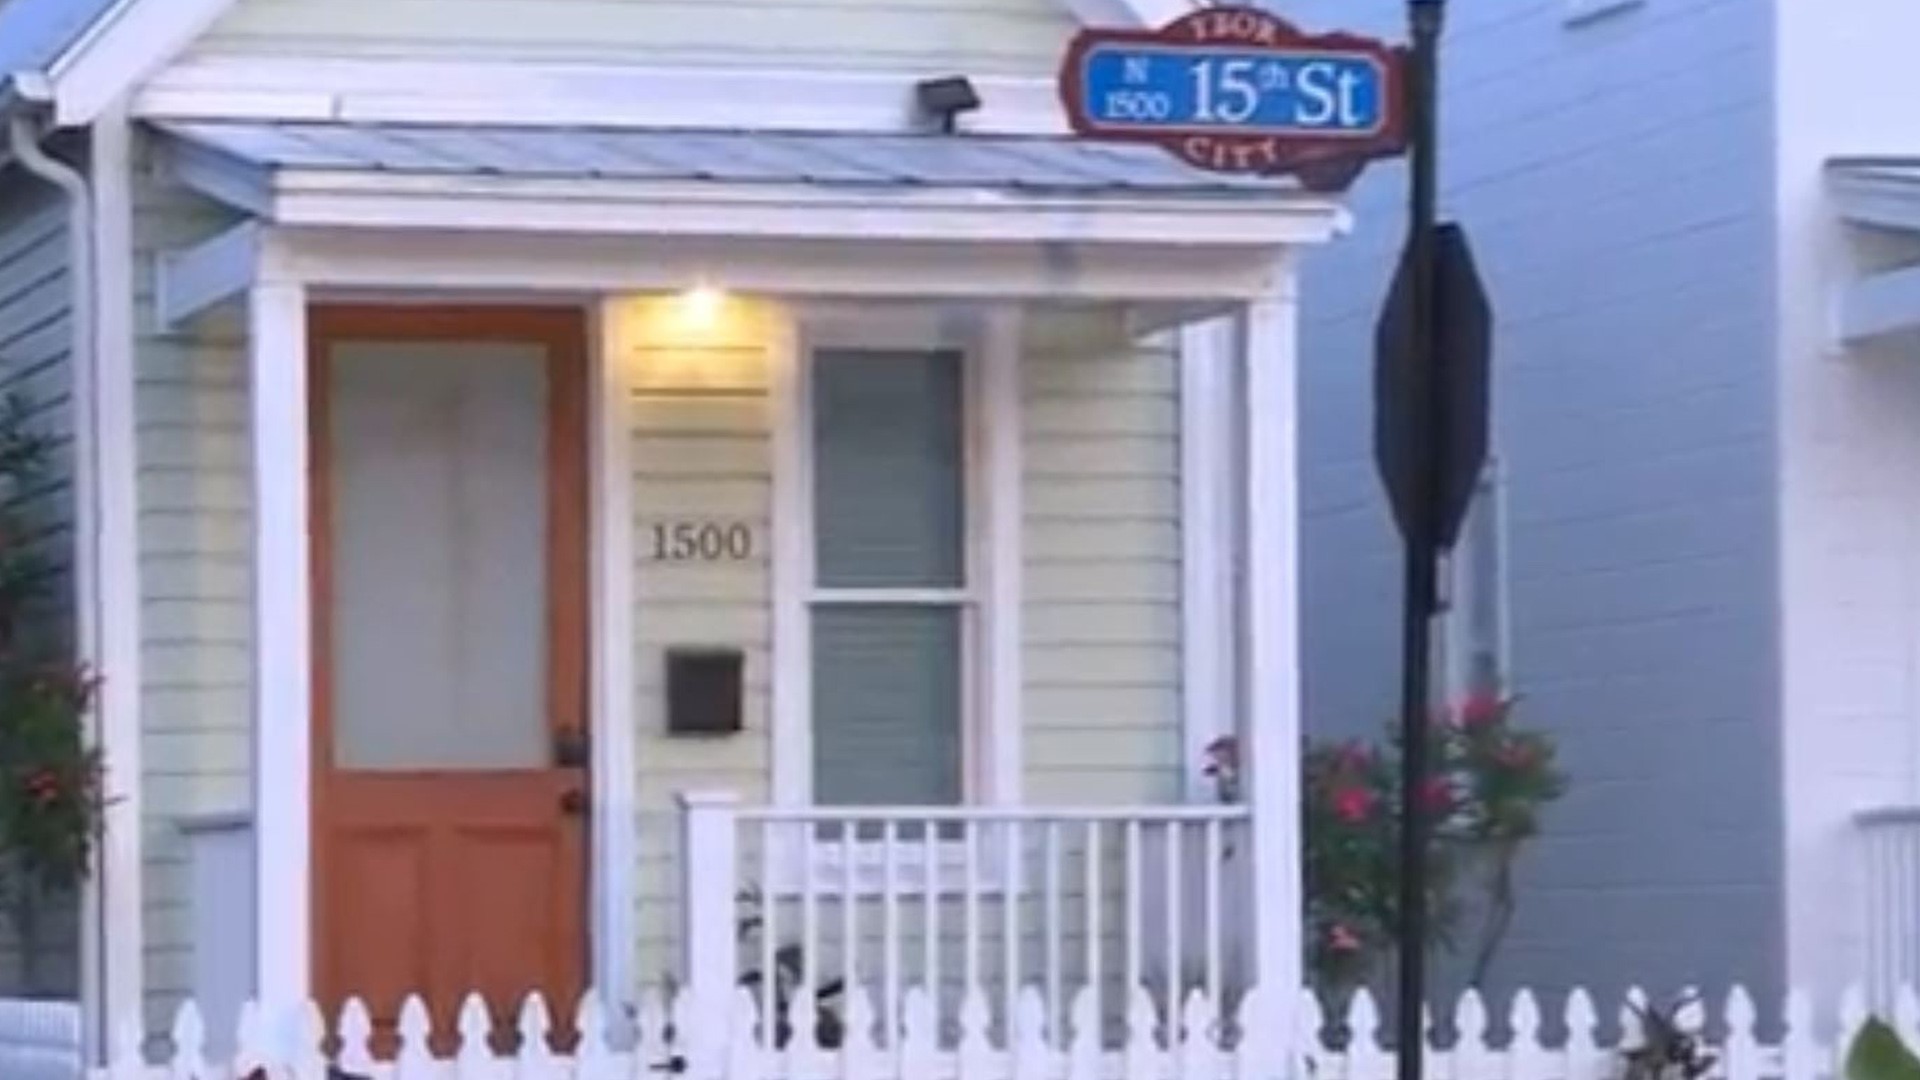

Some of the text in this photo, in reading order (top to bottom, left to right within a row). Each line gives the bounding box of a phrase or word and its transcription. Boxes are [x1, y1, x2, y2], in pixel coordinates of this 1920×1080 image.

[1122, 57, 1149, 83] N
[1105, 91, 1170, 119] 1500
[1190, 60, 1362, 126] 15th St
[1183, 137, 1278, 168] CITY
[652, 522, 752, 561] 1500
